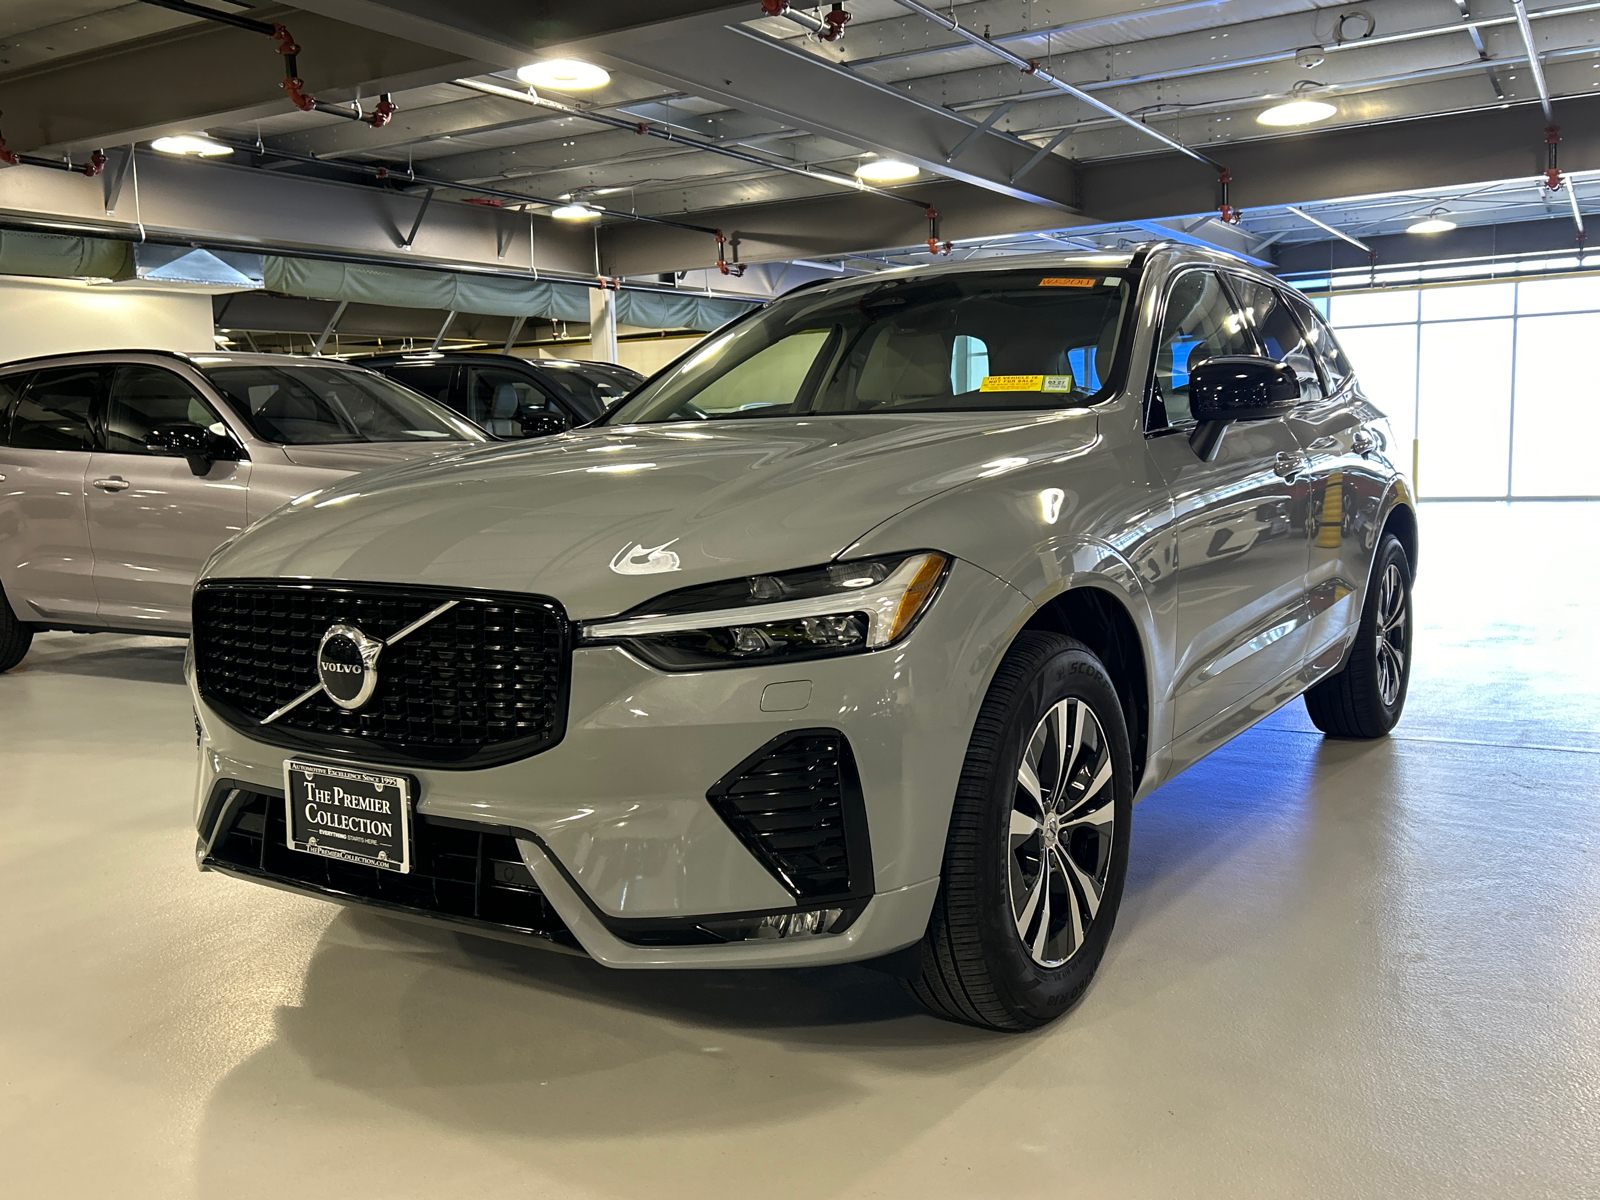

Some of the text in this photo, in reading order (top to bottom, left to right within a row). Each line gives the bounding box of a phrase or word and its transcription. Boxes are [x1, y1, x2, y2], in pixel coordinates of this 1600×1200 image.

[321, 662, 361, 674] VOLVO
[319, 829, 347, 840] EVERYTHING
[347, 834, 364, 844] STARTS
